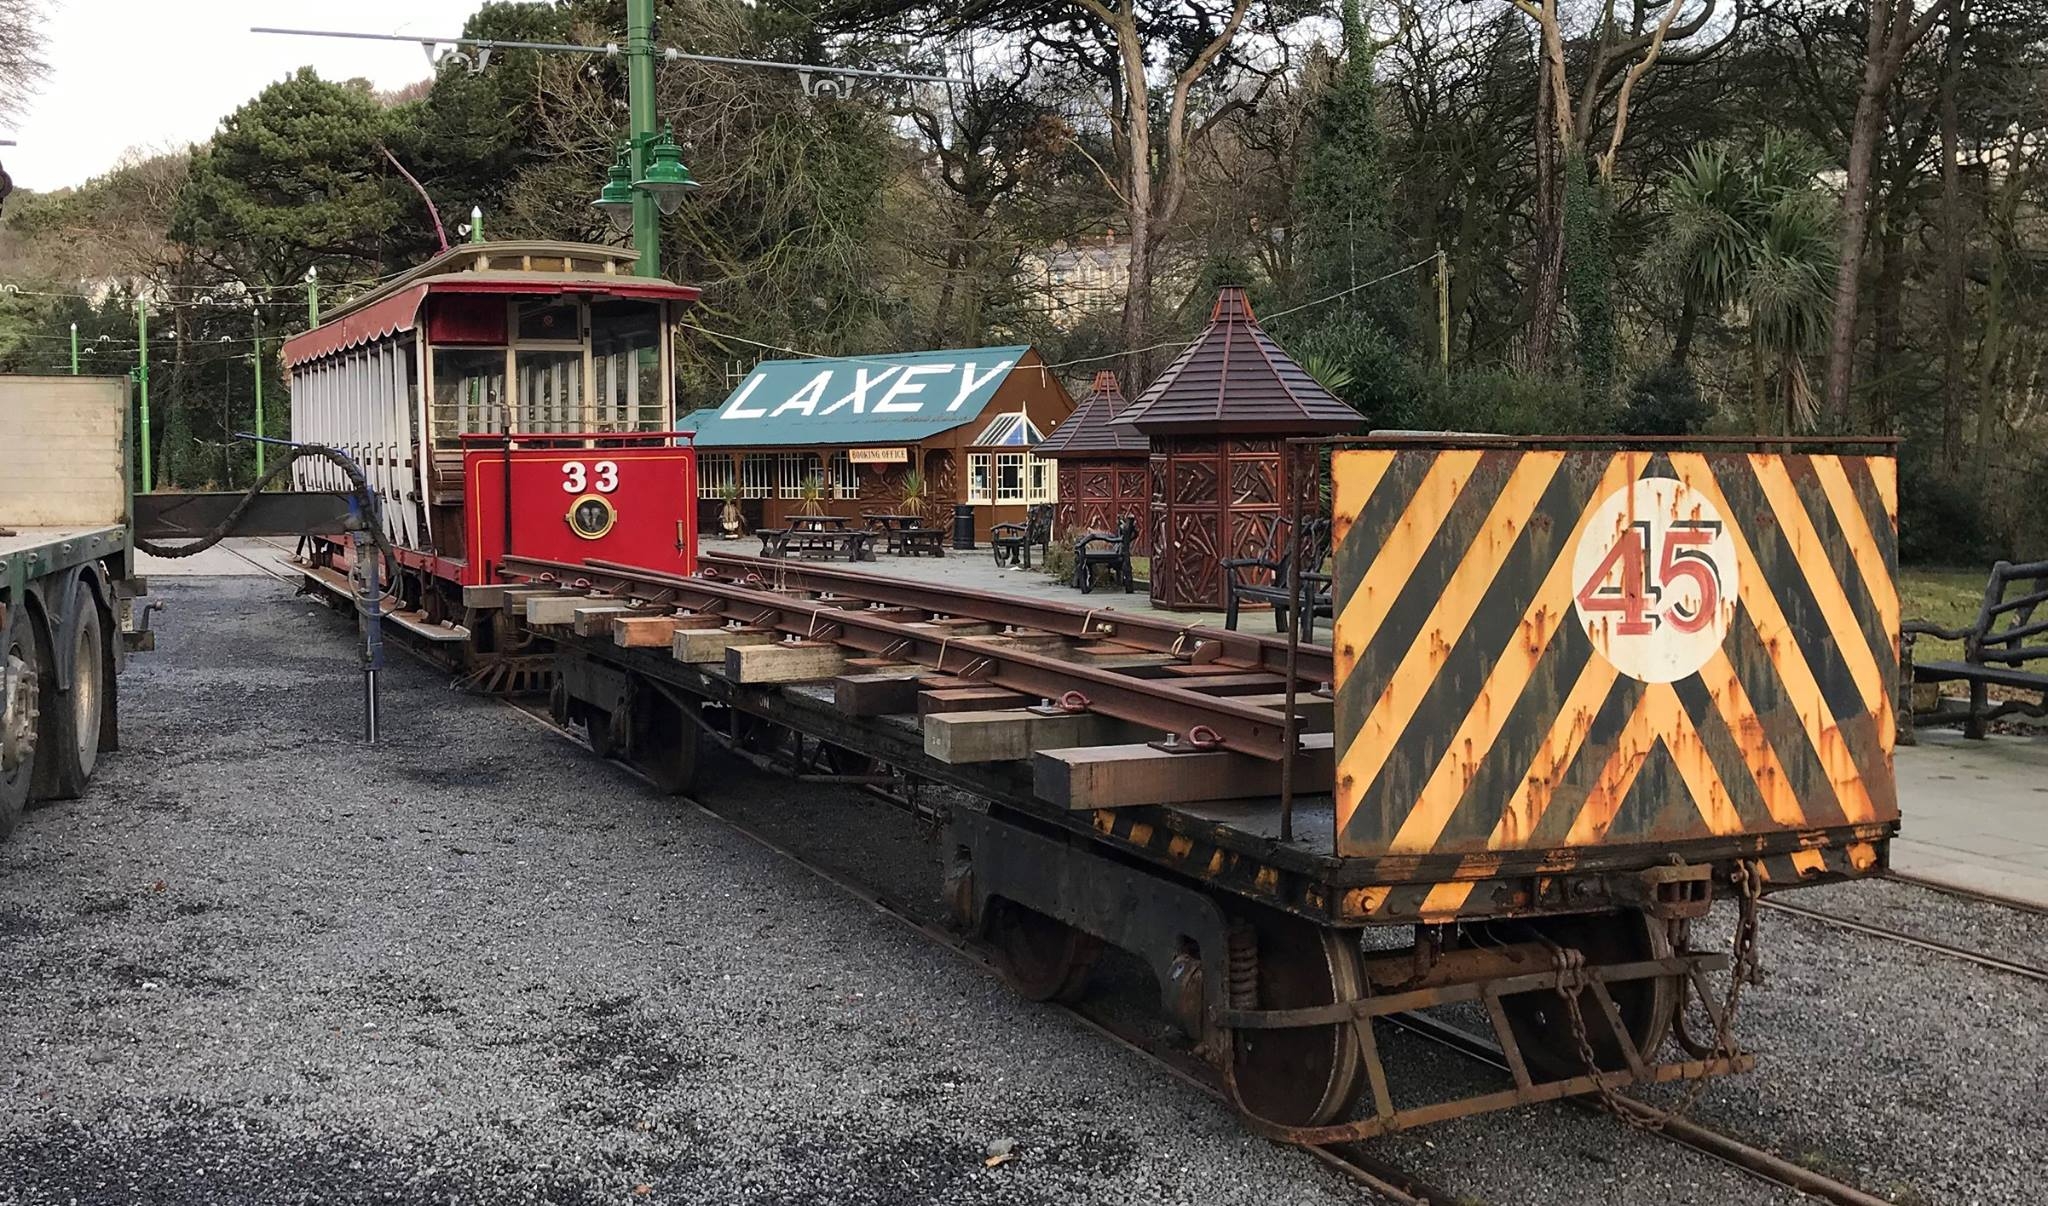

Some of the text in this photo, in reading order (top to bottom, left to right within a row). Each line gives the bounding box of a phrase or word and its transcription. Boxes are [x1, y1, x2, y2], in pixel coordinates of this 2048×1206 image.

[720, 360, 1014, 420] LAXEY
[561, 461, 619, 493] 33
[852, 449, 906, 460] BOOKING OFFICE
[1577, 520, 1722, 636] 45
